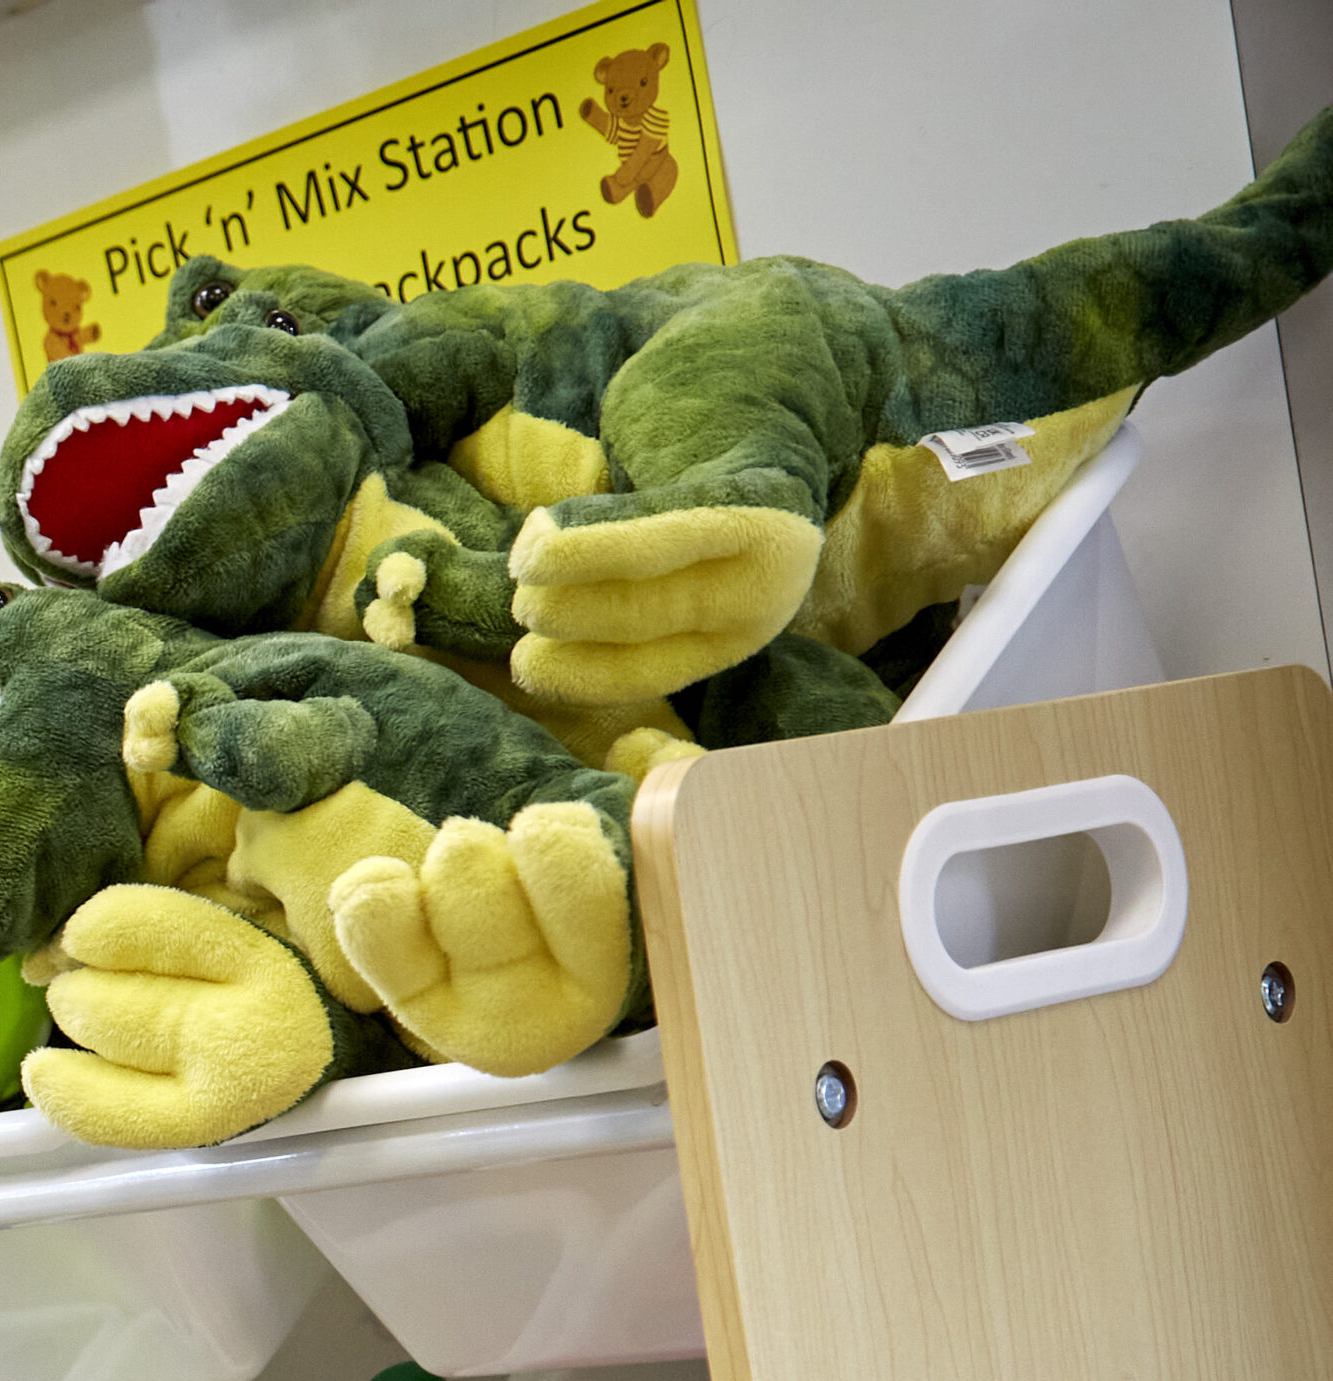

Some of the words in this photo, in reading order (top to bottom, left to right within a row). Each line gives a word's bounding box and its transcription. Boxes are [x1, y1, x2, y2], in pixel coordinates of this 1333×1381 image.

[105, 220, 190, 294] Pick
[275, 162, 370, 230] Mix
[379, 92, 564, 190] Station
